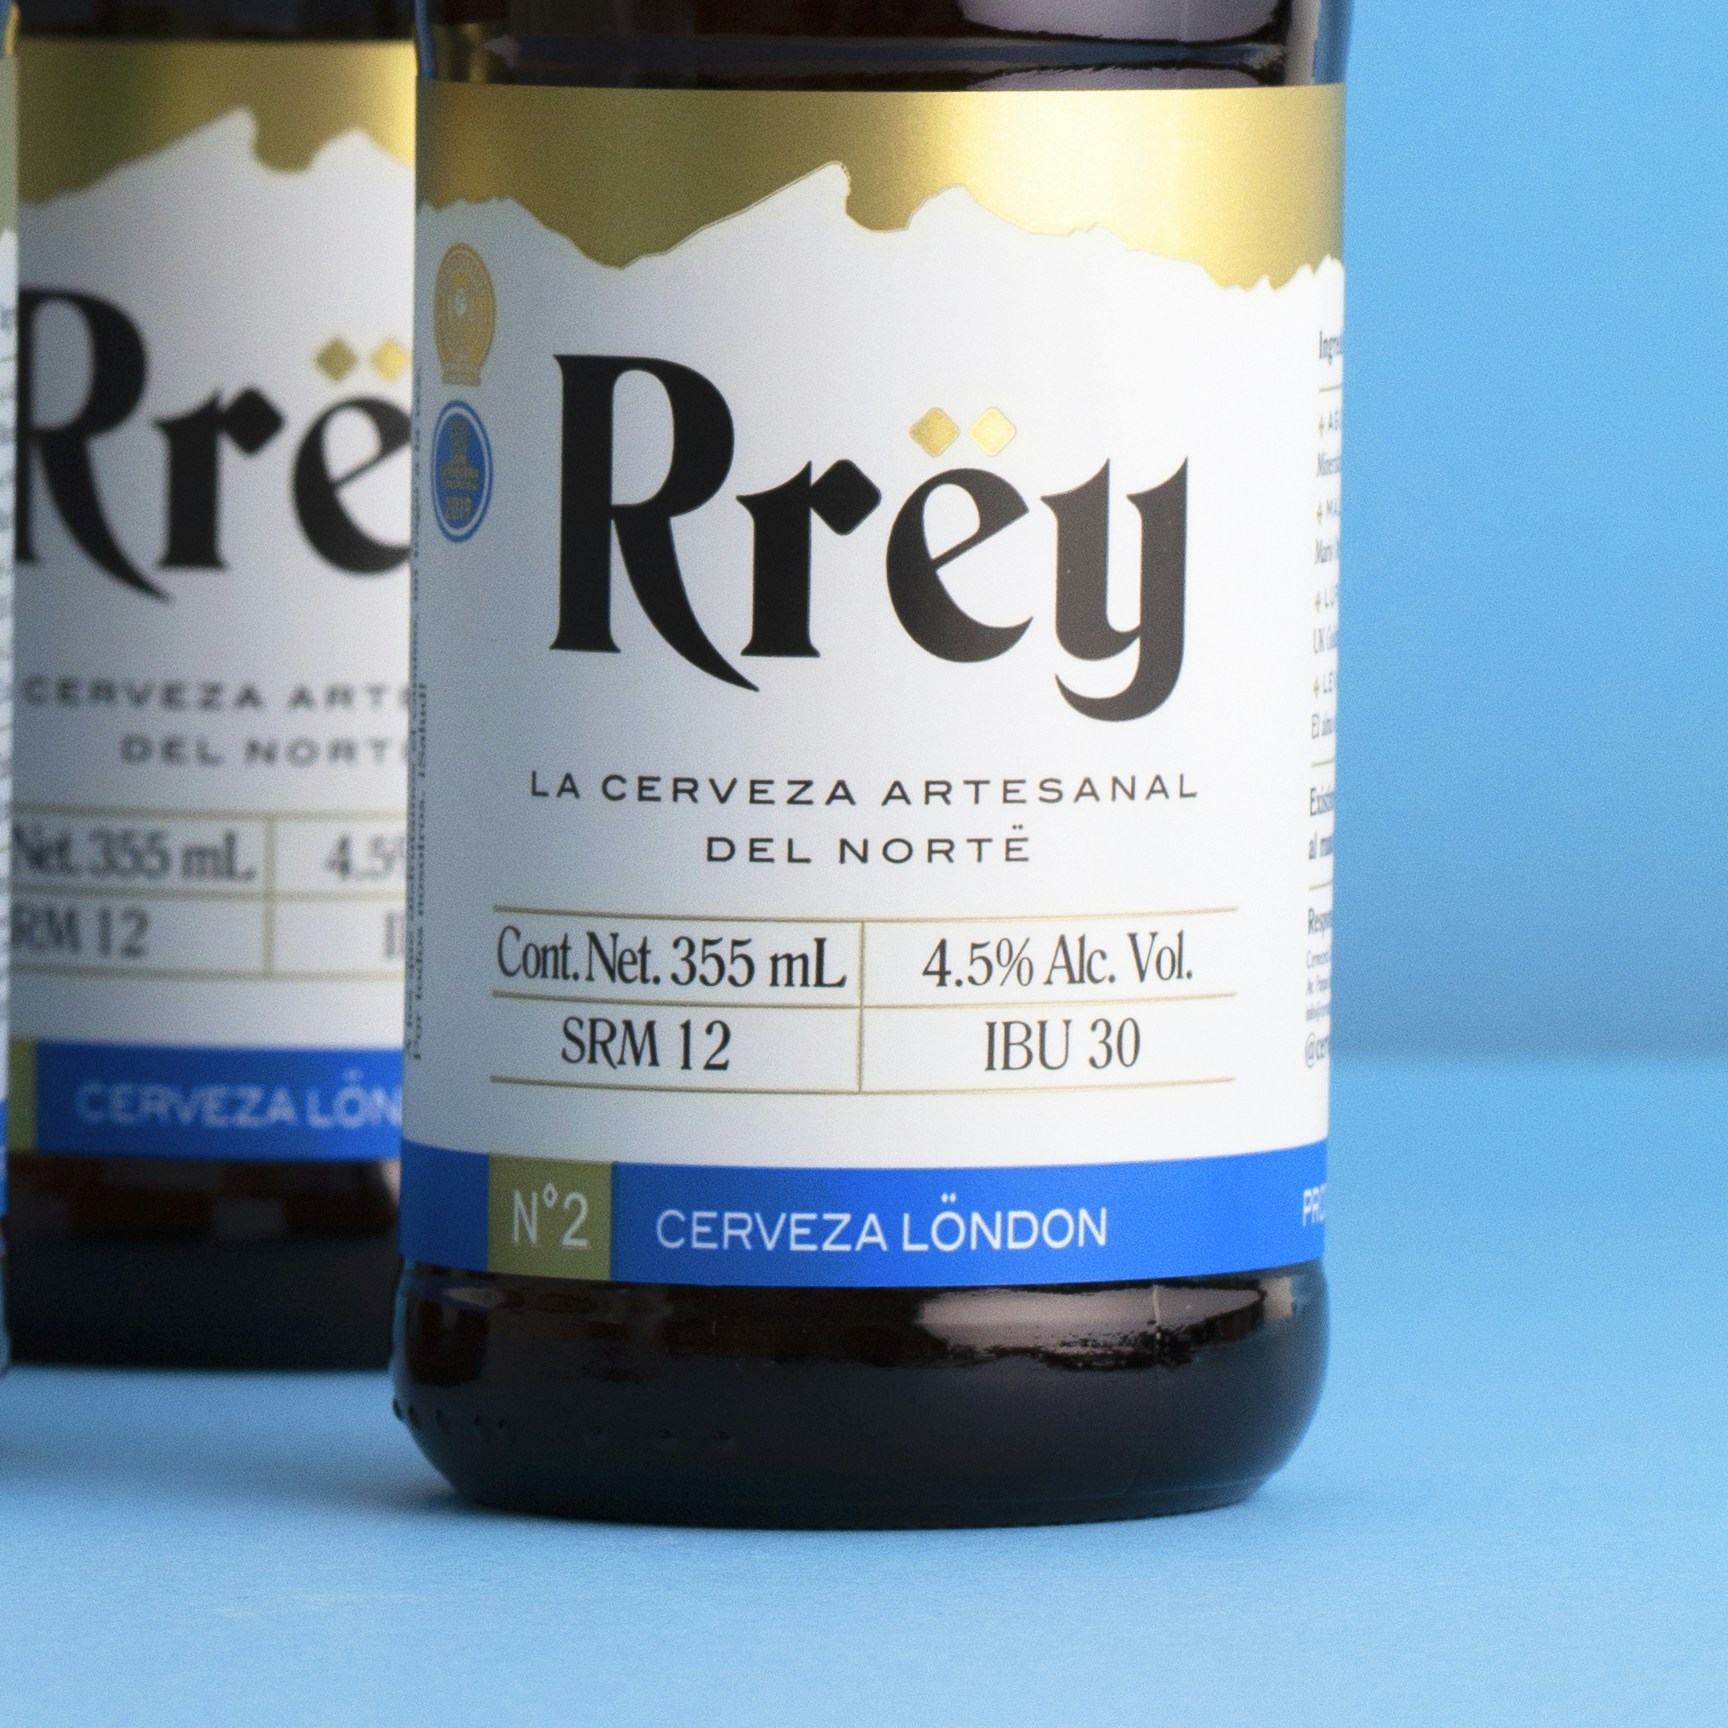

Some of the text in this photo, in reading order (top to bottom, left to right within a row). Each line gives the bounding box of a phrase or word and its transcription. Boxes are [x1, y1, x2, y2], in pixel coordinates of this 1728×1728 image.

[549, 352, 1190, 723] Rrëy
[20, 672, 263, 712] CERVEZA
[119, 732, 410, 768] DEL NORT
[529, 768, 1200, 808] LA CERVEZA ARTESANAL
[705, 823, 1034, 867] DEL NORTË
[97, 906, 150, 959] 12
[920, 928, 1196, 991] 4.5% Alc. Vol.
[669, 934, 758, 990] 355
[768, 936, 849, 991] mL
[559, 1016, 732, 1073] SRM 12
[983, 1016, 1144, 1073] IBU 30
[73, 1079, 297, 1128] CERVEZA
[654, 1191, 1109, 1254] CERVEZA LÖNDON
